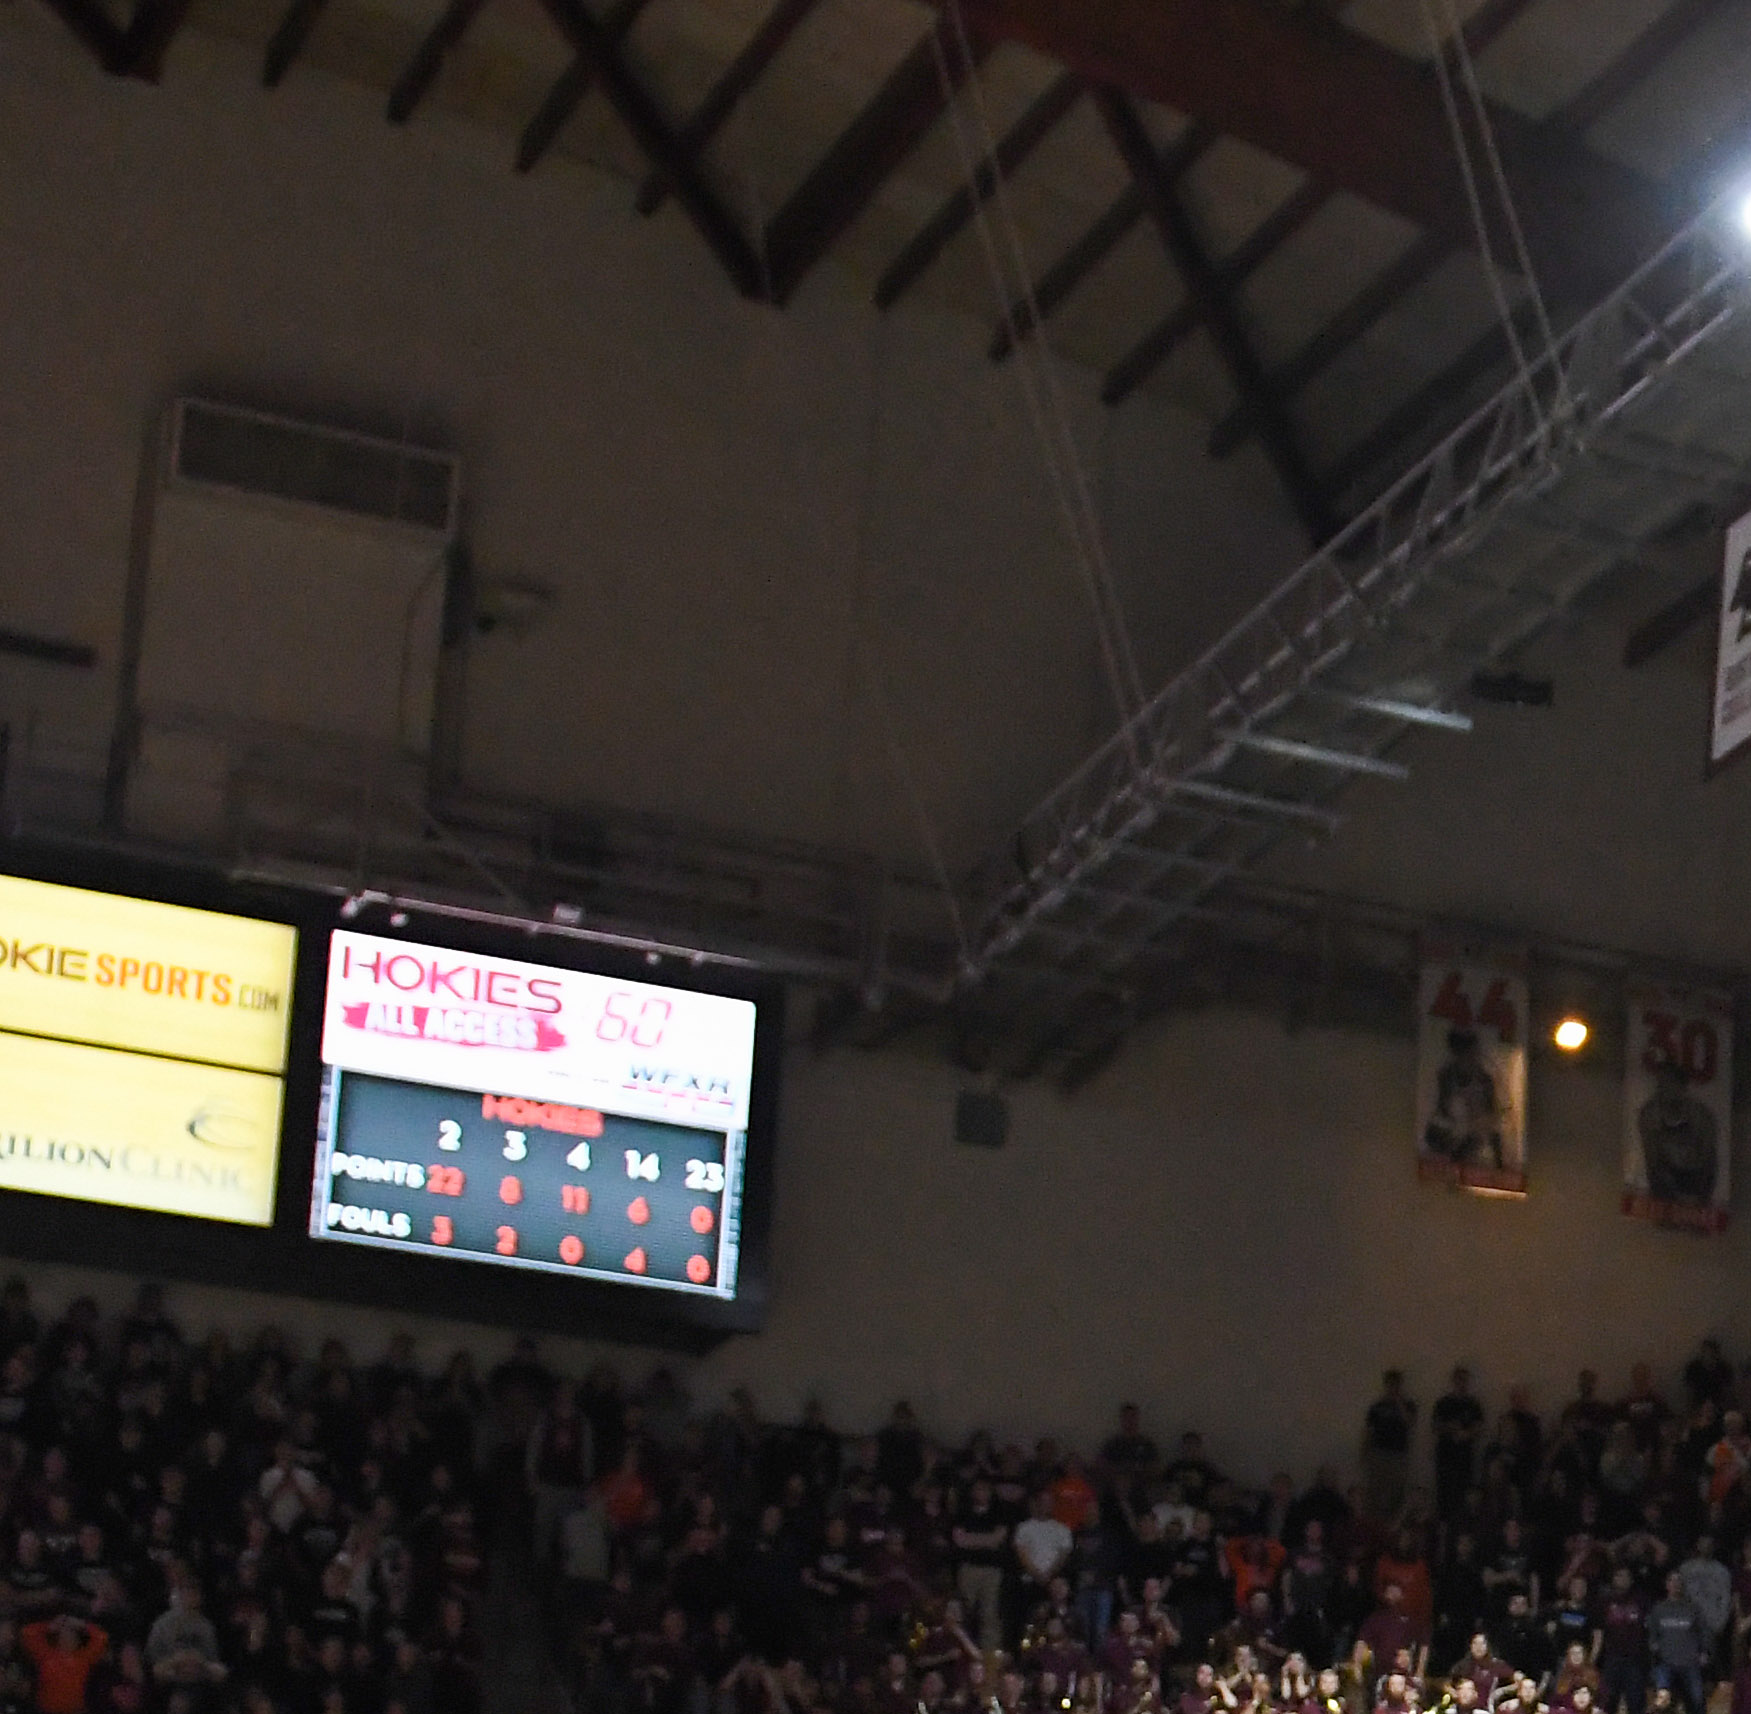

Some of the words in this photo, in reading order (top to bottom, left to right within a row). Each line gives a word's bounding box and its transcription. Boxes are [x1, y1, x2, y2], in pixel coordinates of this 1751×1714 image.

[342, 945, 562, 1014] HOKIES
[1431, 971, 1518, 1043] 44
[365, 1003, 419, 1038] ALL
[423, 1008, 538, 1051] ACCESS
[1642, 1008, 1719, 1086] 30
[0, 1134, 113, 1170] ILION
[332, 1151, 426, 1189] POINTS
[439, 1119, 463, 1151] 2
[502, 1130, 528, 1161] 3
[566, 1141, 592, 1172] 4
[624, 1149, 661, 1182] 14
[685, 1159, 725, 1192] 23
[327, 1203, 412, 1238] FOULS
